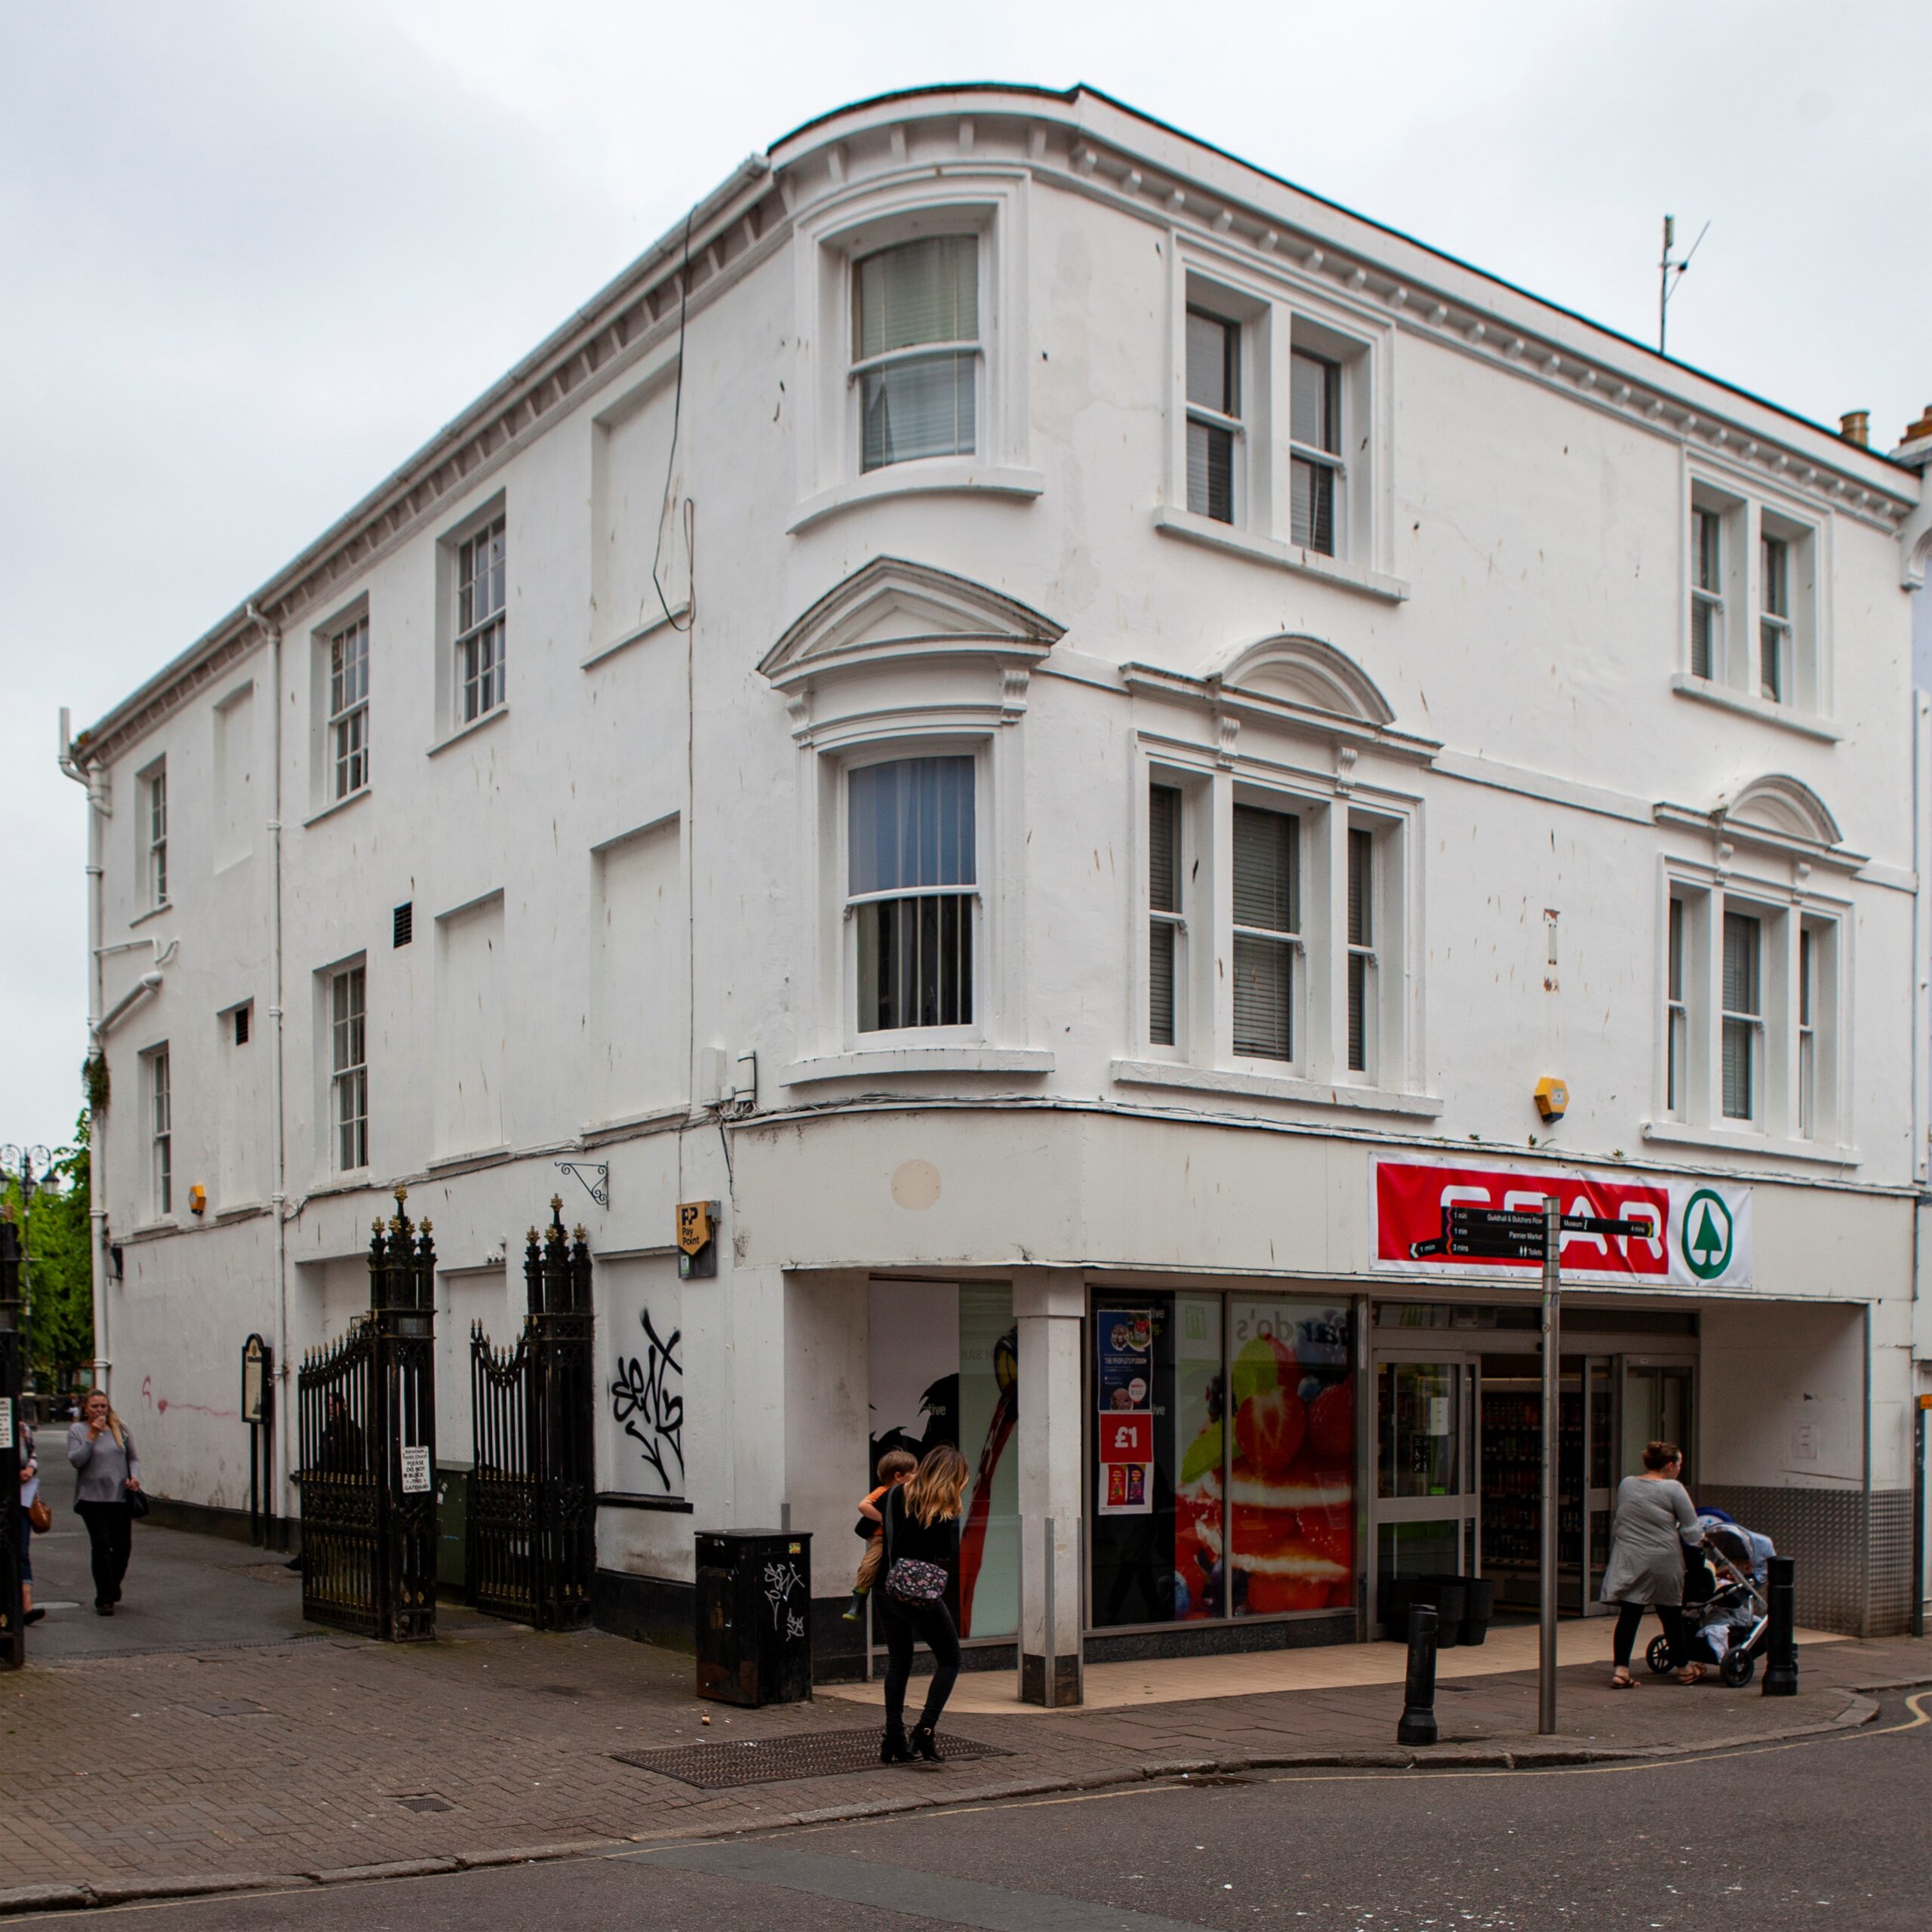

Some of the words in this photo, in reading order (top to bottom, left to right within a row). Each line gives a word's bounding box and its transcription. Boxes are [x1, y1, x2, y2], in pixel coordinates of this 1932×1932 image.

[1487, 1214, 1506, 1223] Guildhall
[1512, 1215, 1532, 1223] Butchers
[1564, 1220, 1583, 1228] Museum
[682, 1227, 694, 1238] Pay
[1509, 1231, 1526, 1240] Pannier
[1527, 1232, 1543, 1241] Market
[683, 1236, 700, 1246] Point
[1528, 1247, 1543, 1257] Toilets
[1115, 1426, 1138, 1448] £1
